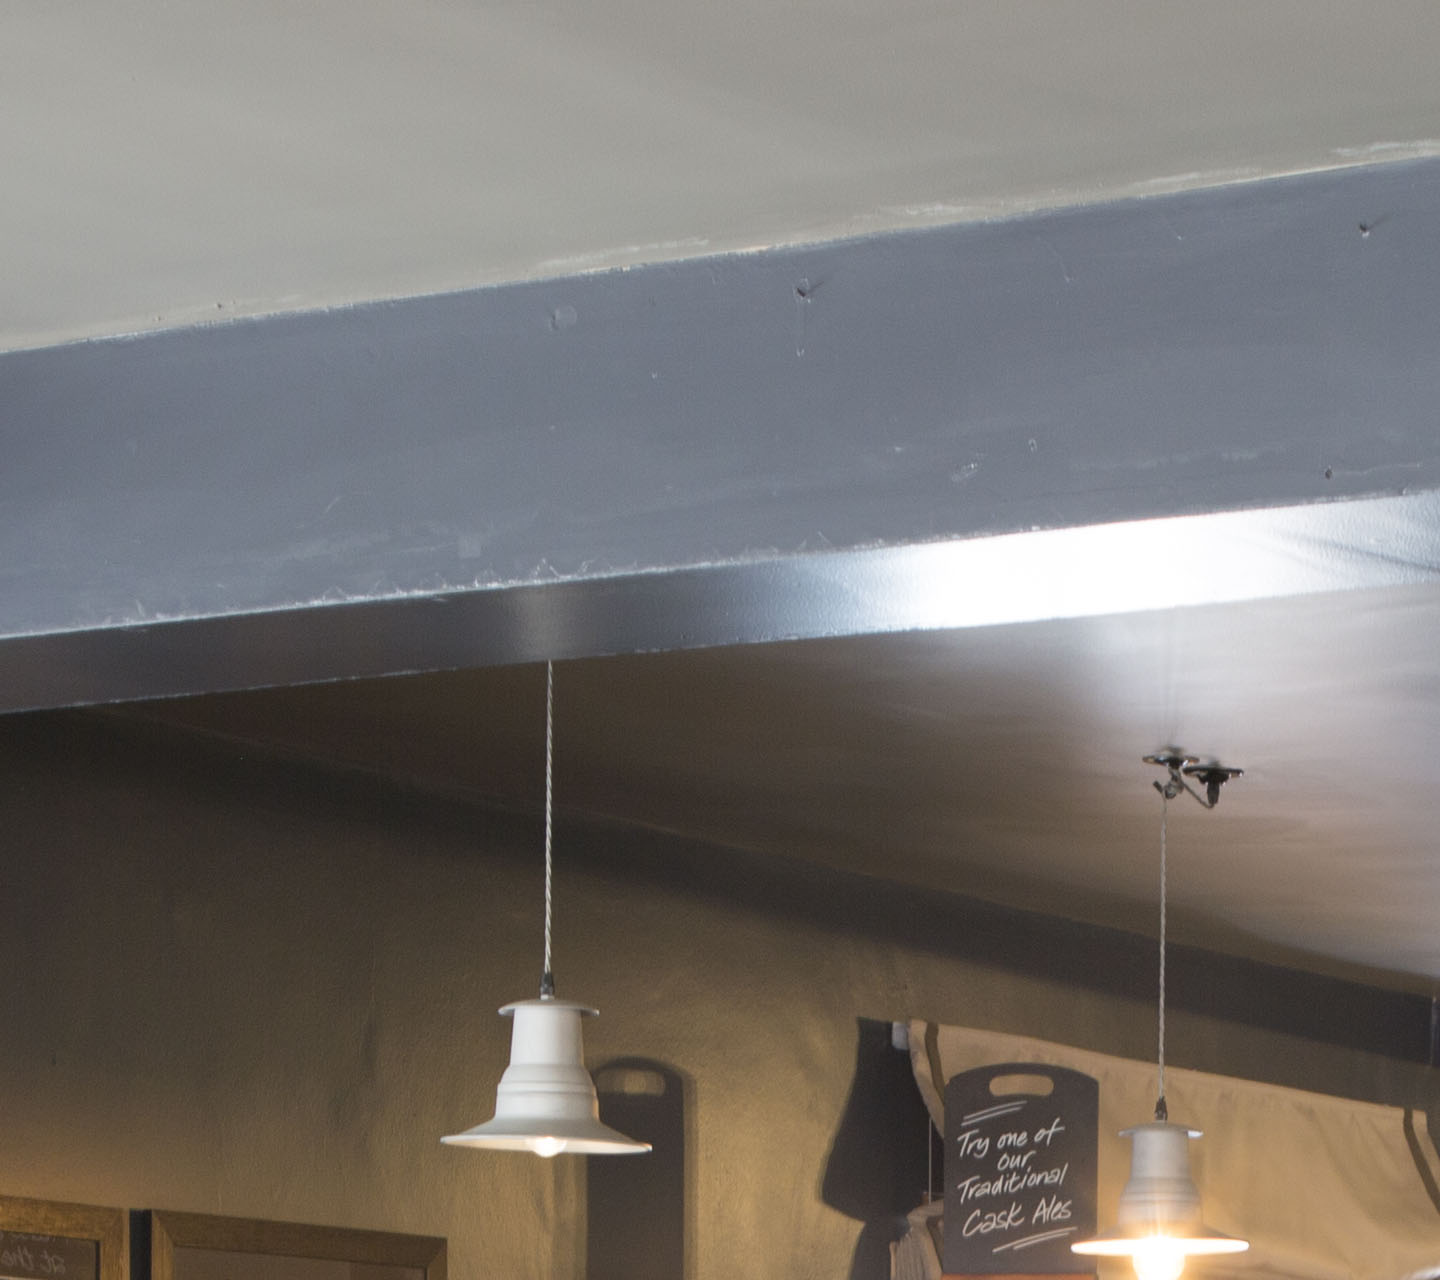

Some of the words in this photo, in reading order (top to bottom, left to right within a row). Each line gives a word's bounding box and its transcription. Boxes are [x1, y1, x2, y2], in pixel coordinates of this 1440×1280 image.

[957, 1128, 990, 1159] Try
[997, 1131, 1029, 1149] one
[1034, 1117, 1065, 1147] of
[997, 1150, 1037, 1171] our
[957, 1162, 1069, 1205] Traditional
[962, 1200, 1025, 1237] Cask
[1032, 1194, 1072, 1225] Ales
